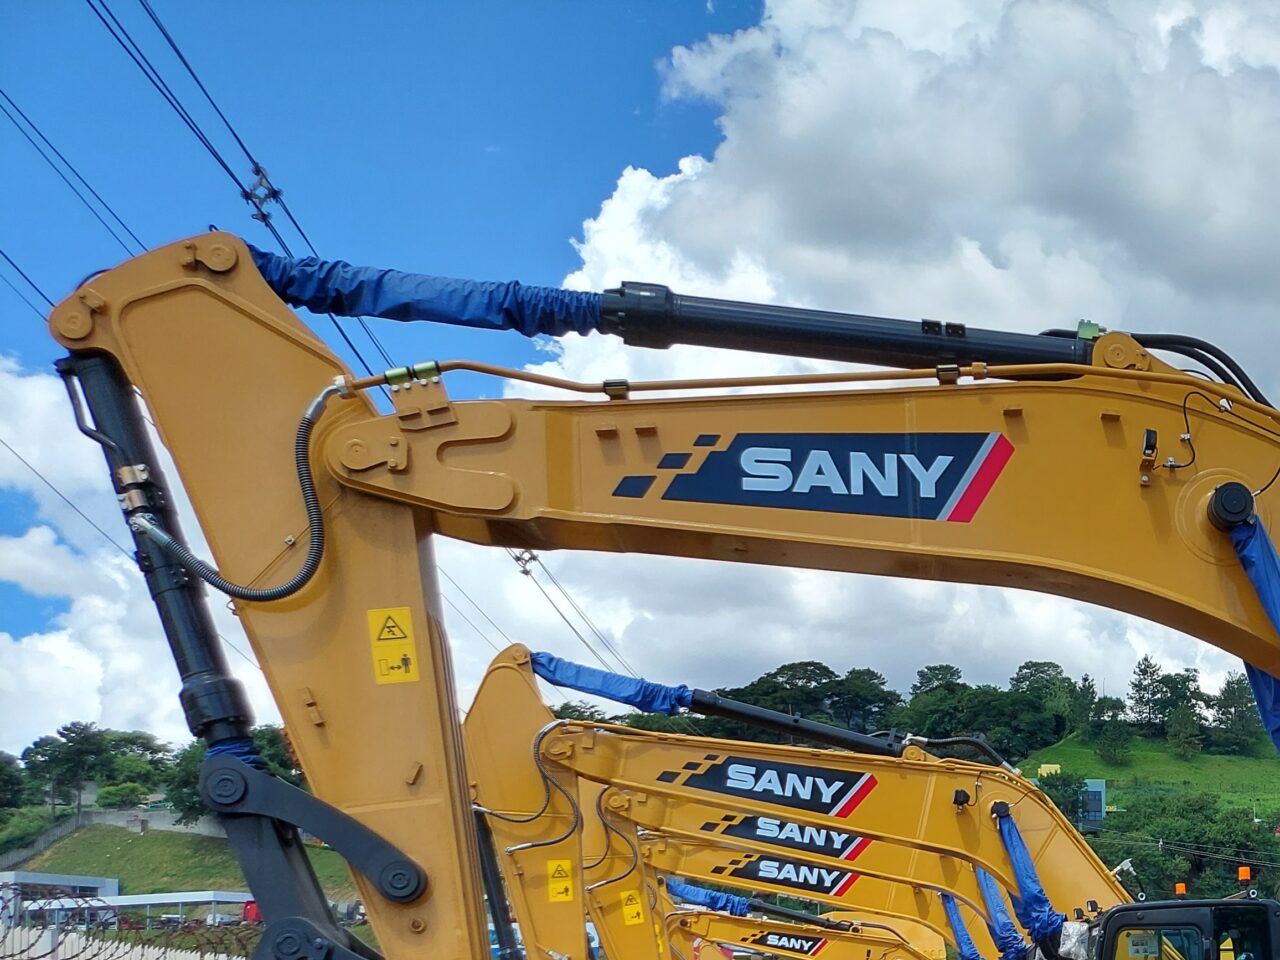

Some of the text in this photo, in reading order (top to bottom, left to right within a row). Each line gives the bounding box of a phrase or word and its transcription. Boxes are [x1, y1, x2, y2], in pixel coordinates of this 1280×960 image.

[740, 446, 954, 498] SANY
[726, 764, 844, 803] SANY
[756, 817, 849, 849] SANY
[758, 860, 840, 887] SANY
[766, 934, 813, 951] SANY
